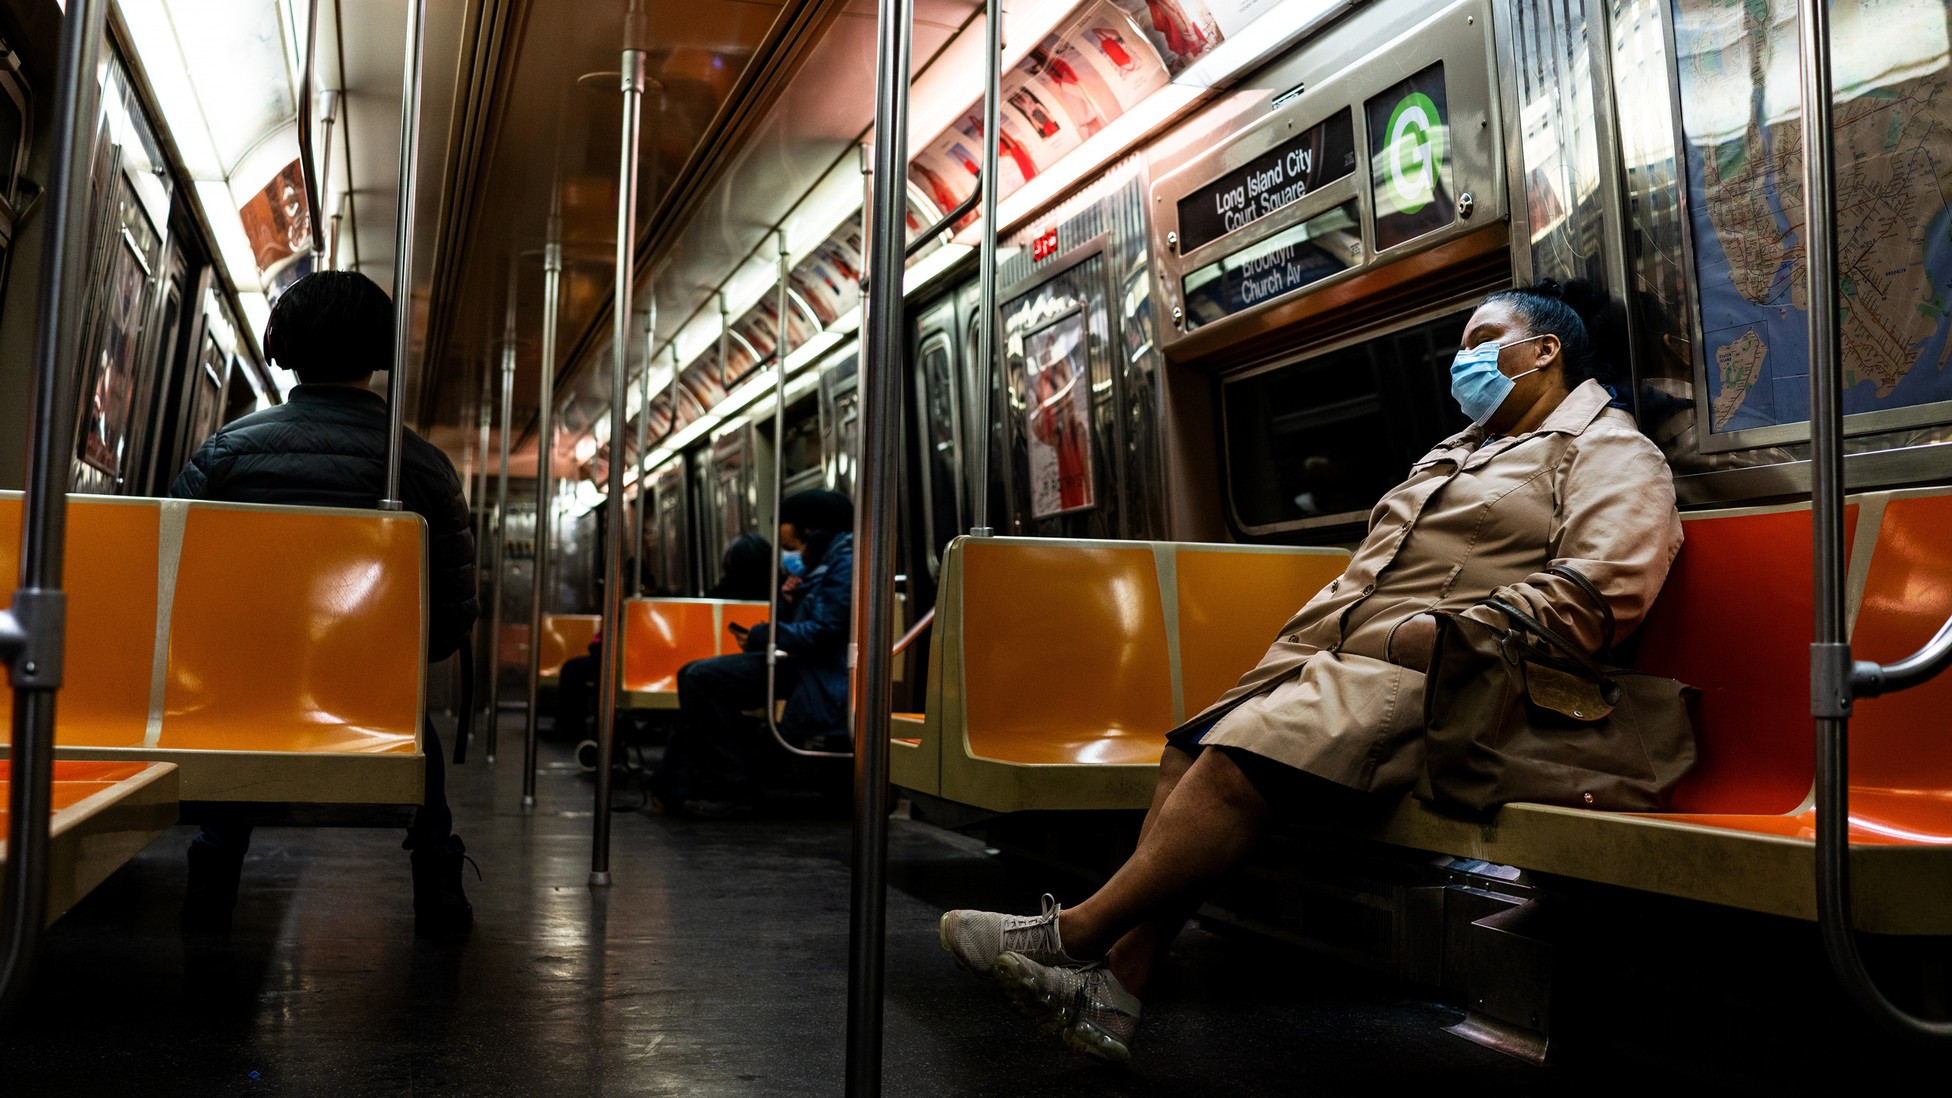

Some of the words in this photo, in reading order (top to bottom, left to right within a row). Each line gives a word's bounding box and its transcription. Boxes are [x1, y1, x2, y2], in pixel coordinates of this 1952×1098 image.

[1389, 106, 1434, 200] G
[1215, 185, 1245, 215] Long
[1247, 159, 1284, 198] Island
[1286, 148, 1313, 177] City
[1224, 200, 1258, 232] Court
[1260, 180, 1306, 214] Square
[1241, 268, 1284, 304] Church
[1286, 262, 1301, 287] Av
[1242, 242, 1295, 278] Brooklyn
